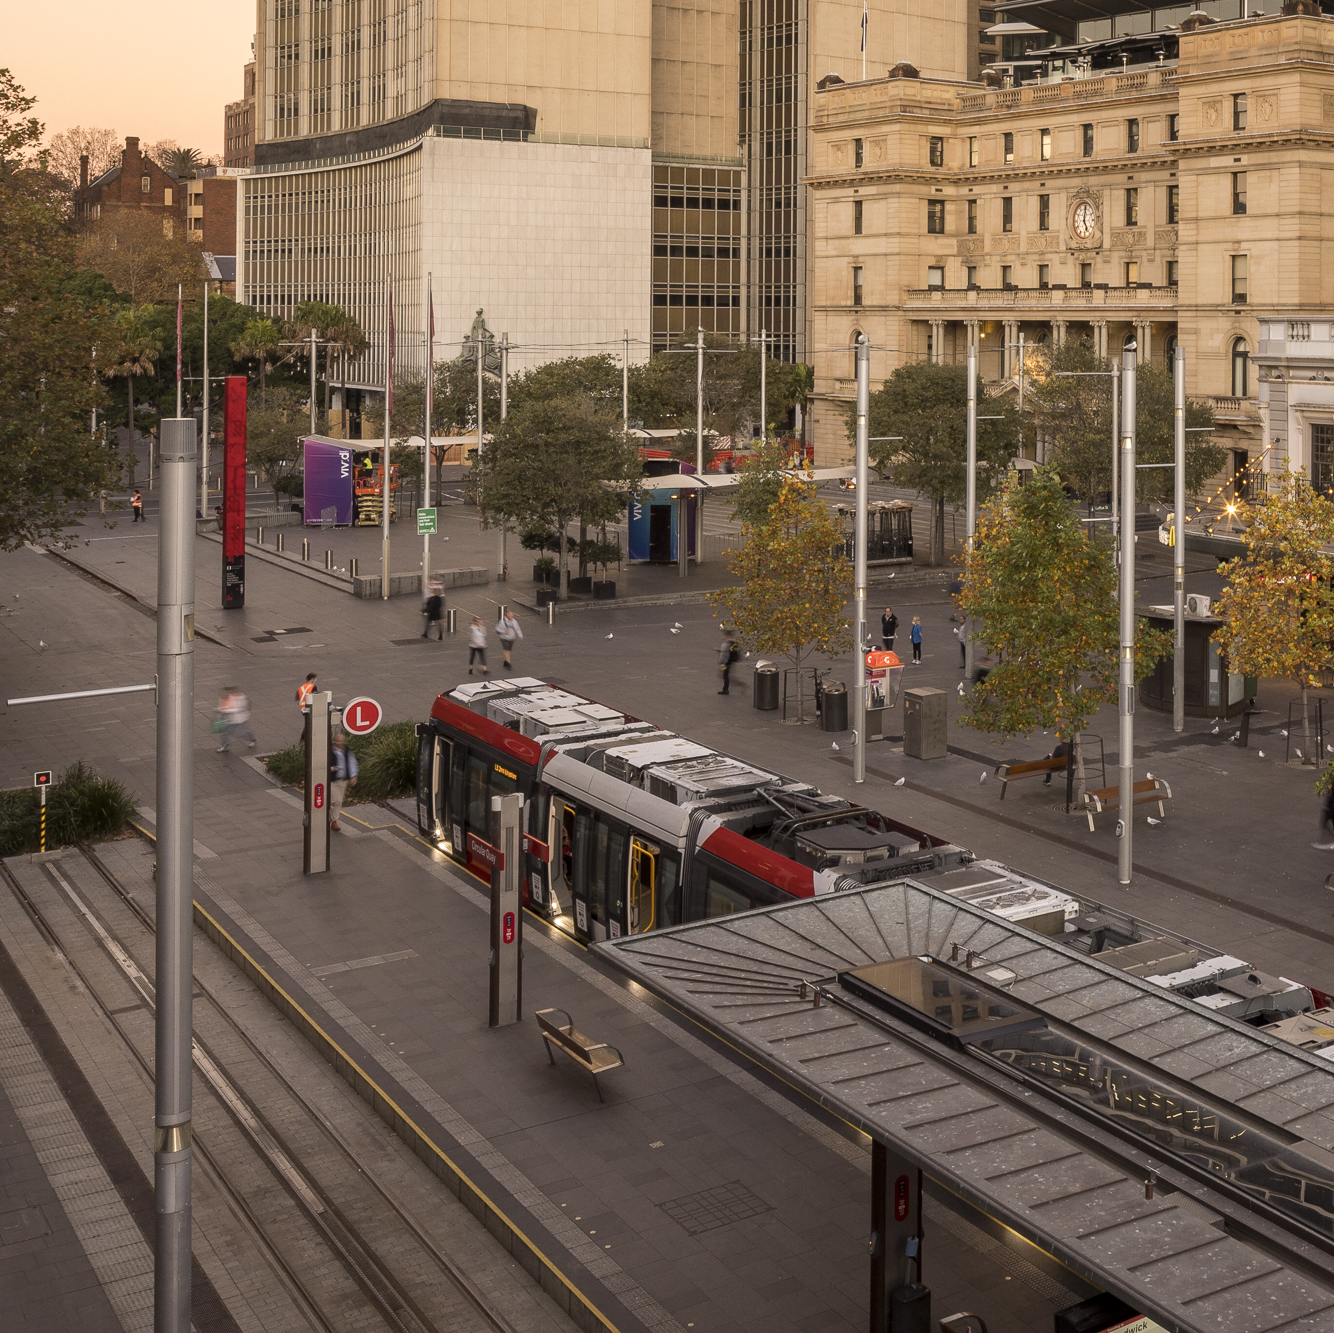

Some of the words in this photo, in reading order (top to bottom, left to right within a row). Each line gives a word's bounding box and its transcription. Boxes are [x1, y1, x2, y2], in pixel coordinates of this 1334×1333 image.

[356, 706, 370, 727] L
[472, 840, 486, 857] Circular
[486, 848, 496, 865] Quay
